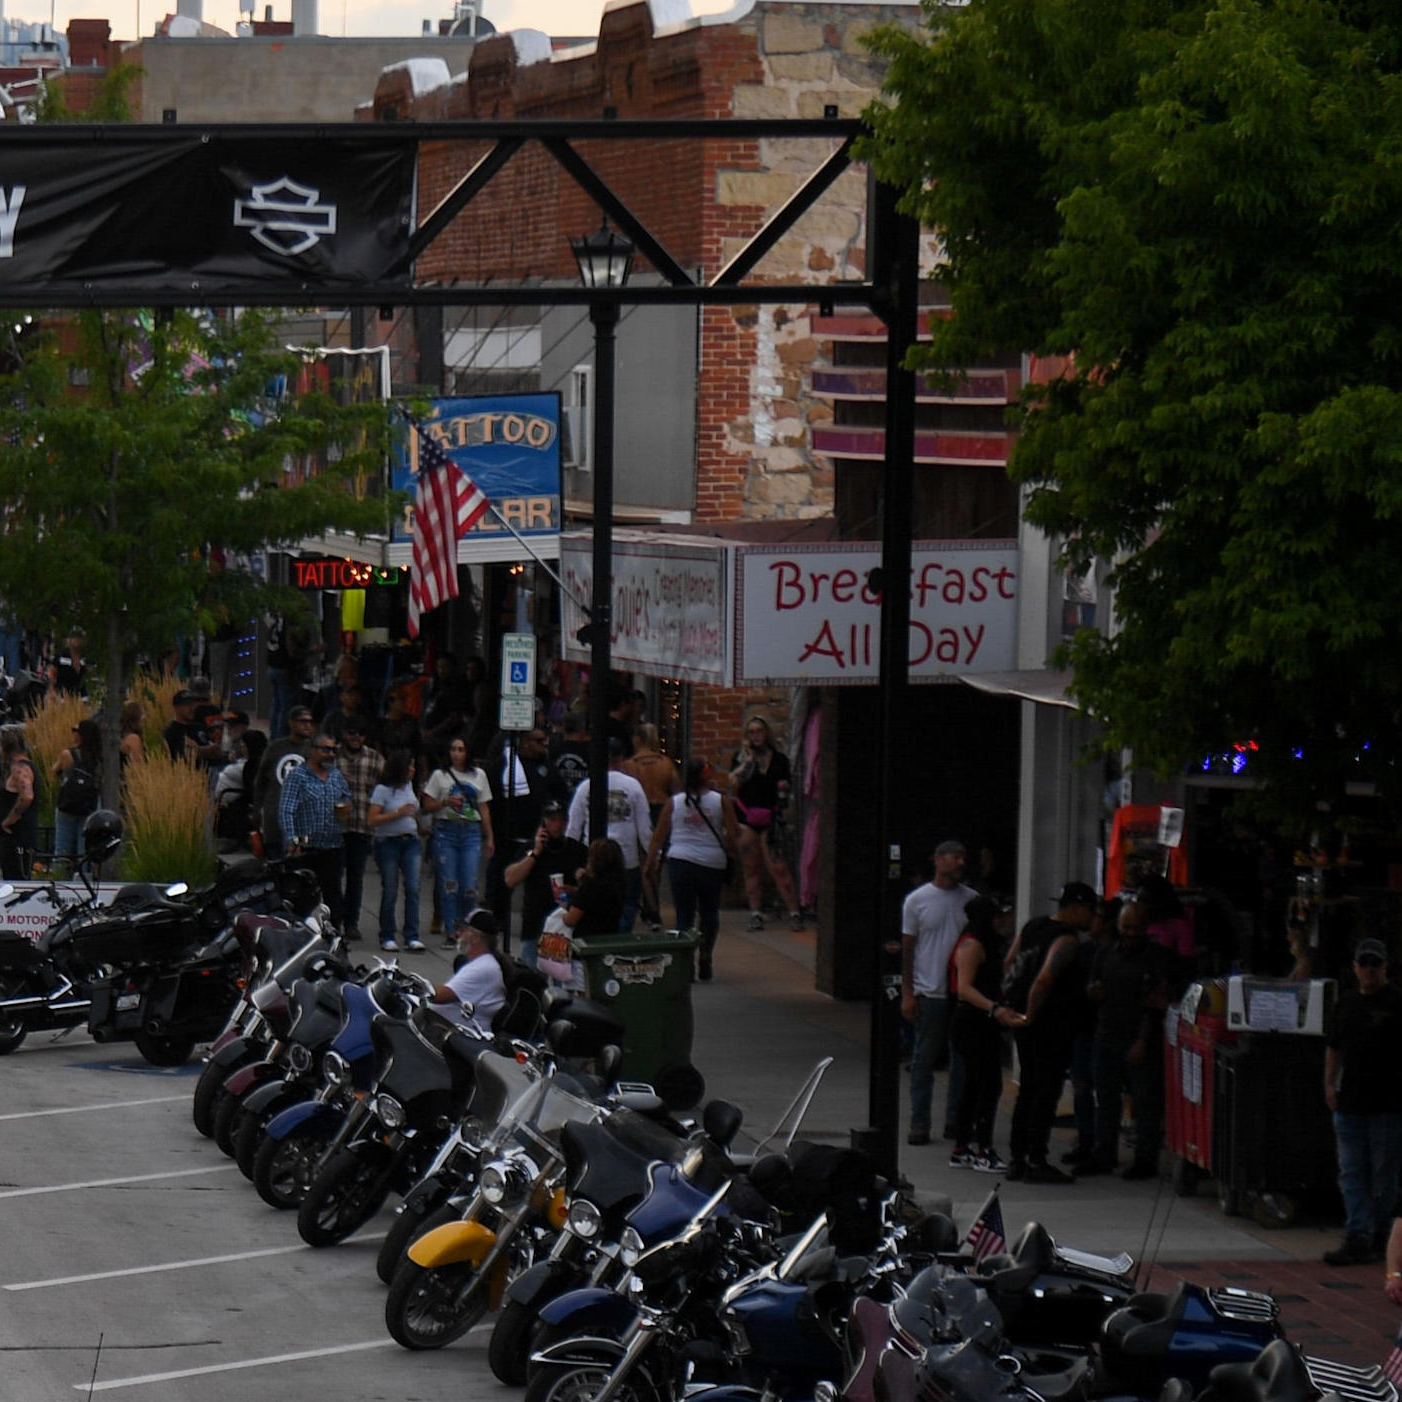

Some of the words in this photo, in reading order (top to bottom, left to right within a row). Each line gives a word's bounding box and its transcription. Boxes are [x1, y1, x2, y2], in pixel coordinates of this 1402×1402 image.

[294, 562, 372, 587] TATTOO
[769, 560, 1016, 611] Breafast
[798, 619, 871, 669] All
